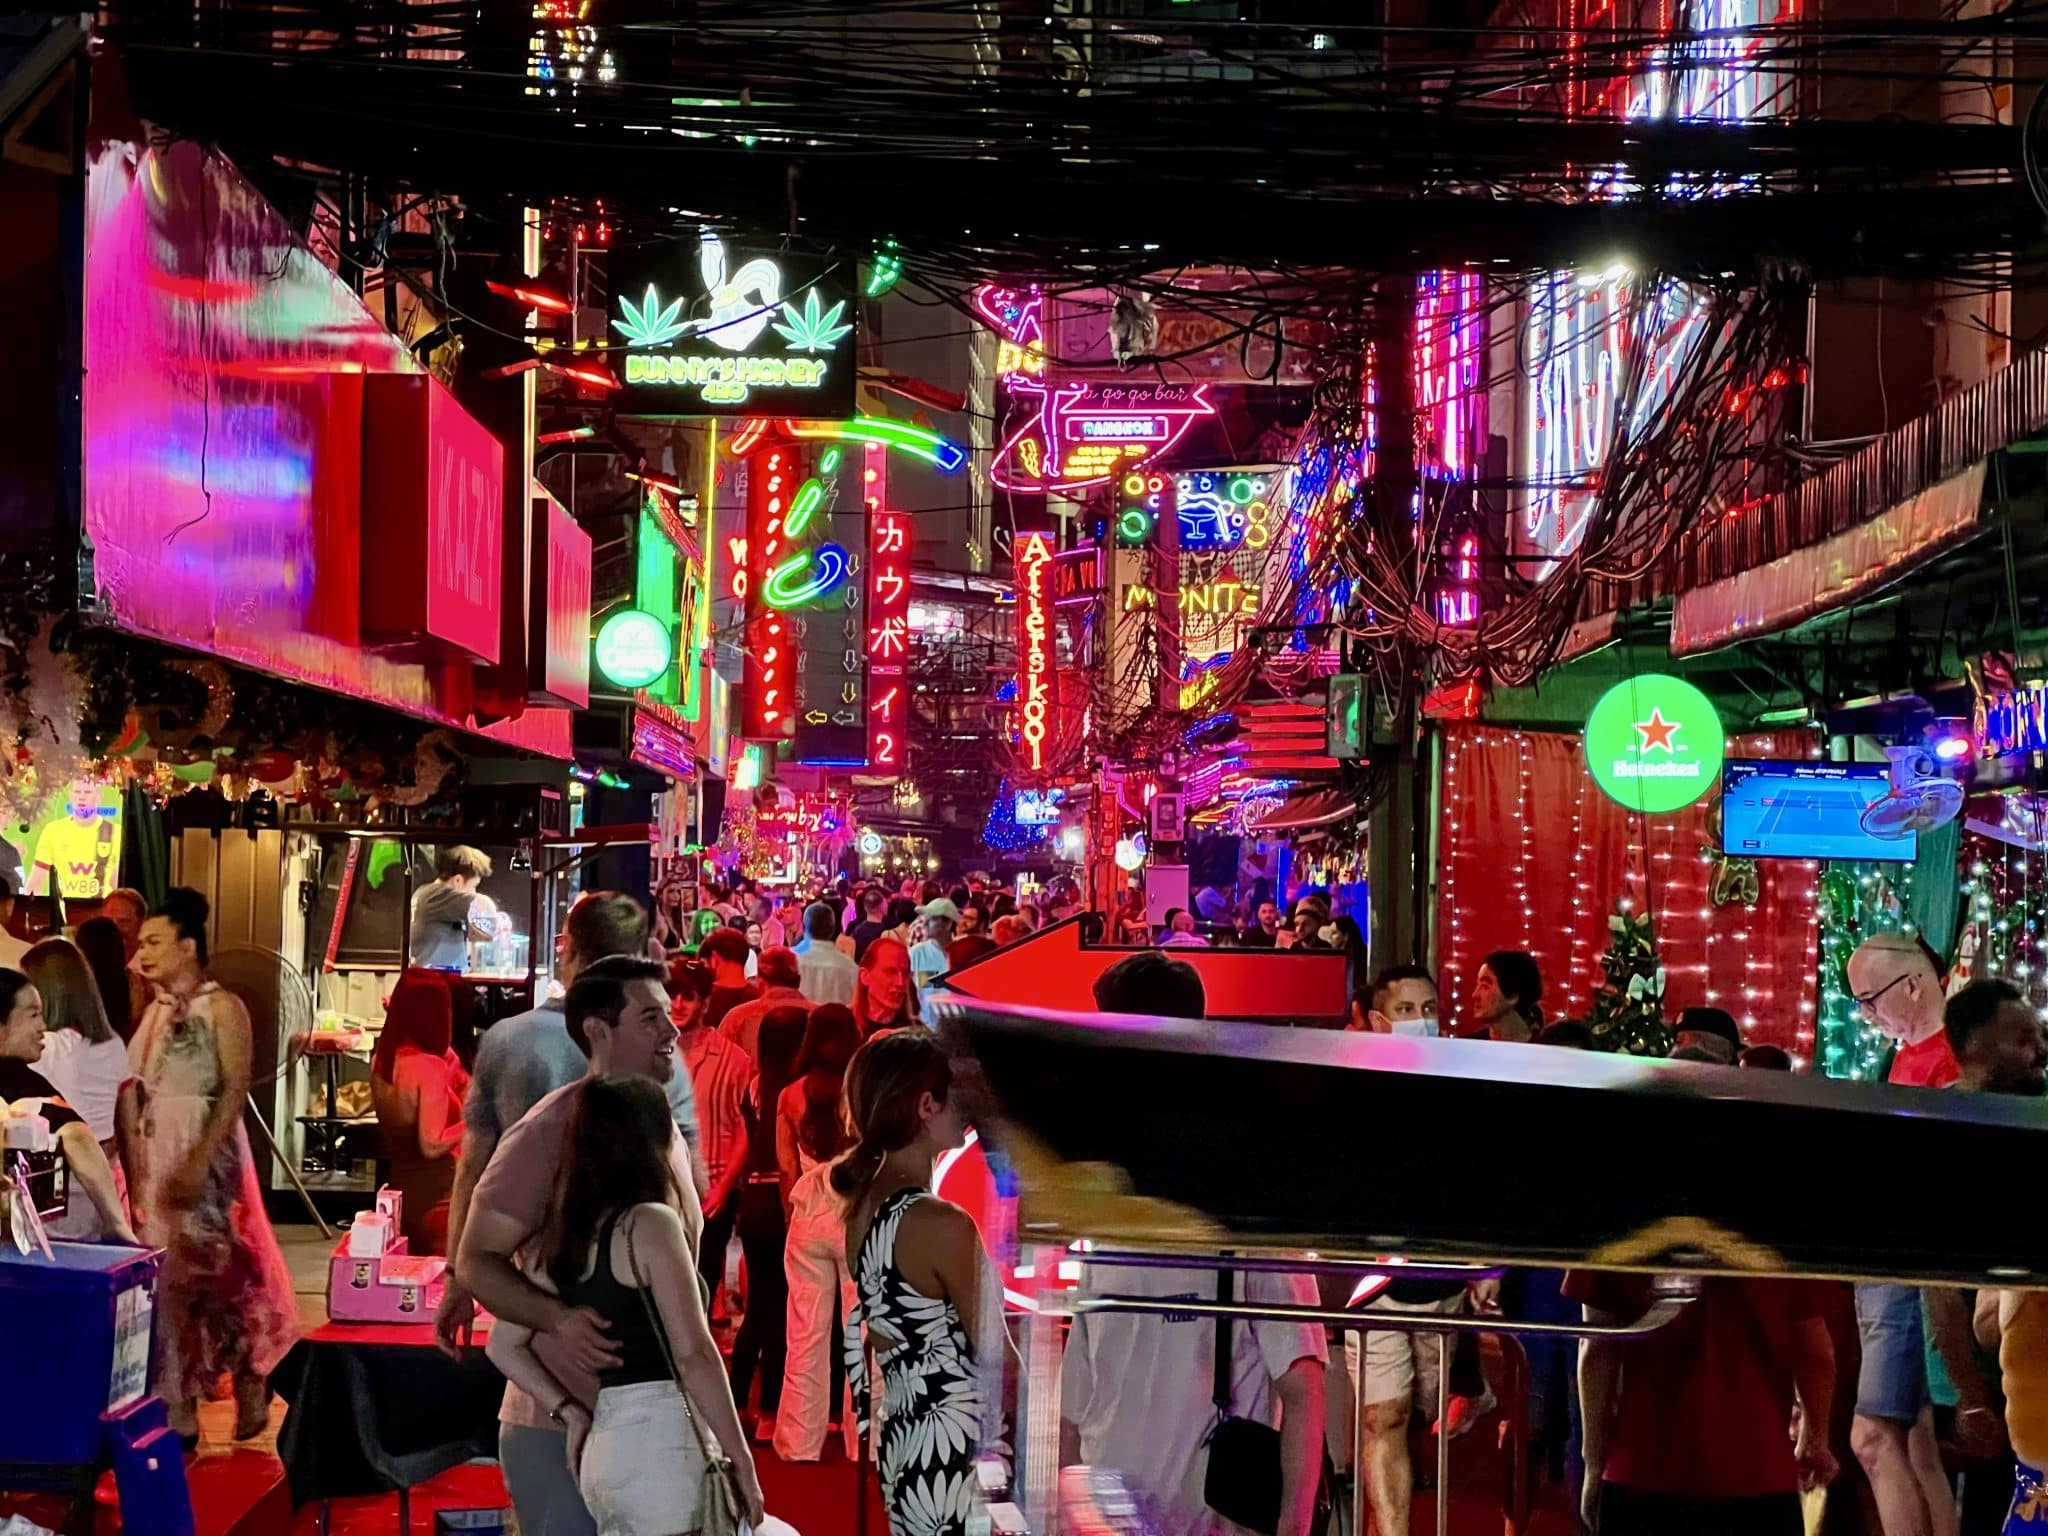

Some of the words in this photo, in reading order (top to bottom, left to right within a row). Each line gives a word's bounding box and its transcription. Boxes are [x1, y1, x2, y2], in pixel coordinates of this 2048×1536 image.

[625, 355, 735, 383] BUNNY'S
[735, 357, 827, 387] HONEY
[700, 382, 748, 404] 420
[1102, 388, 1125, 408] go
[1128, 388, 1152, 408] go
[1154, 384, 1189, 401] bar
[1125, 583, 1261, 614] MNITE
[1612, 759, 1700, 777] Heineken
[65, 880, 98, 893] W88
